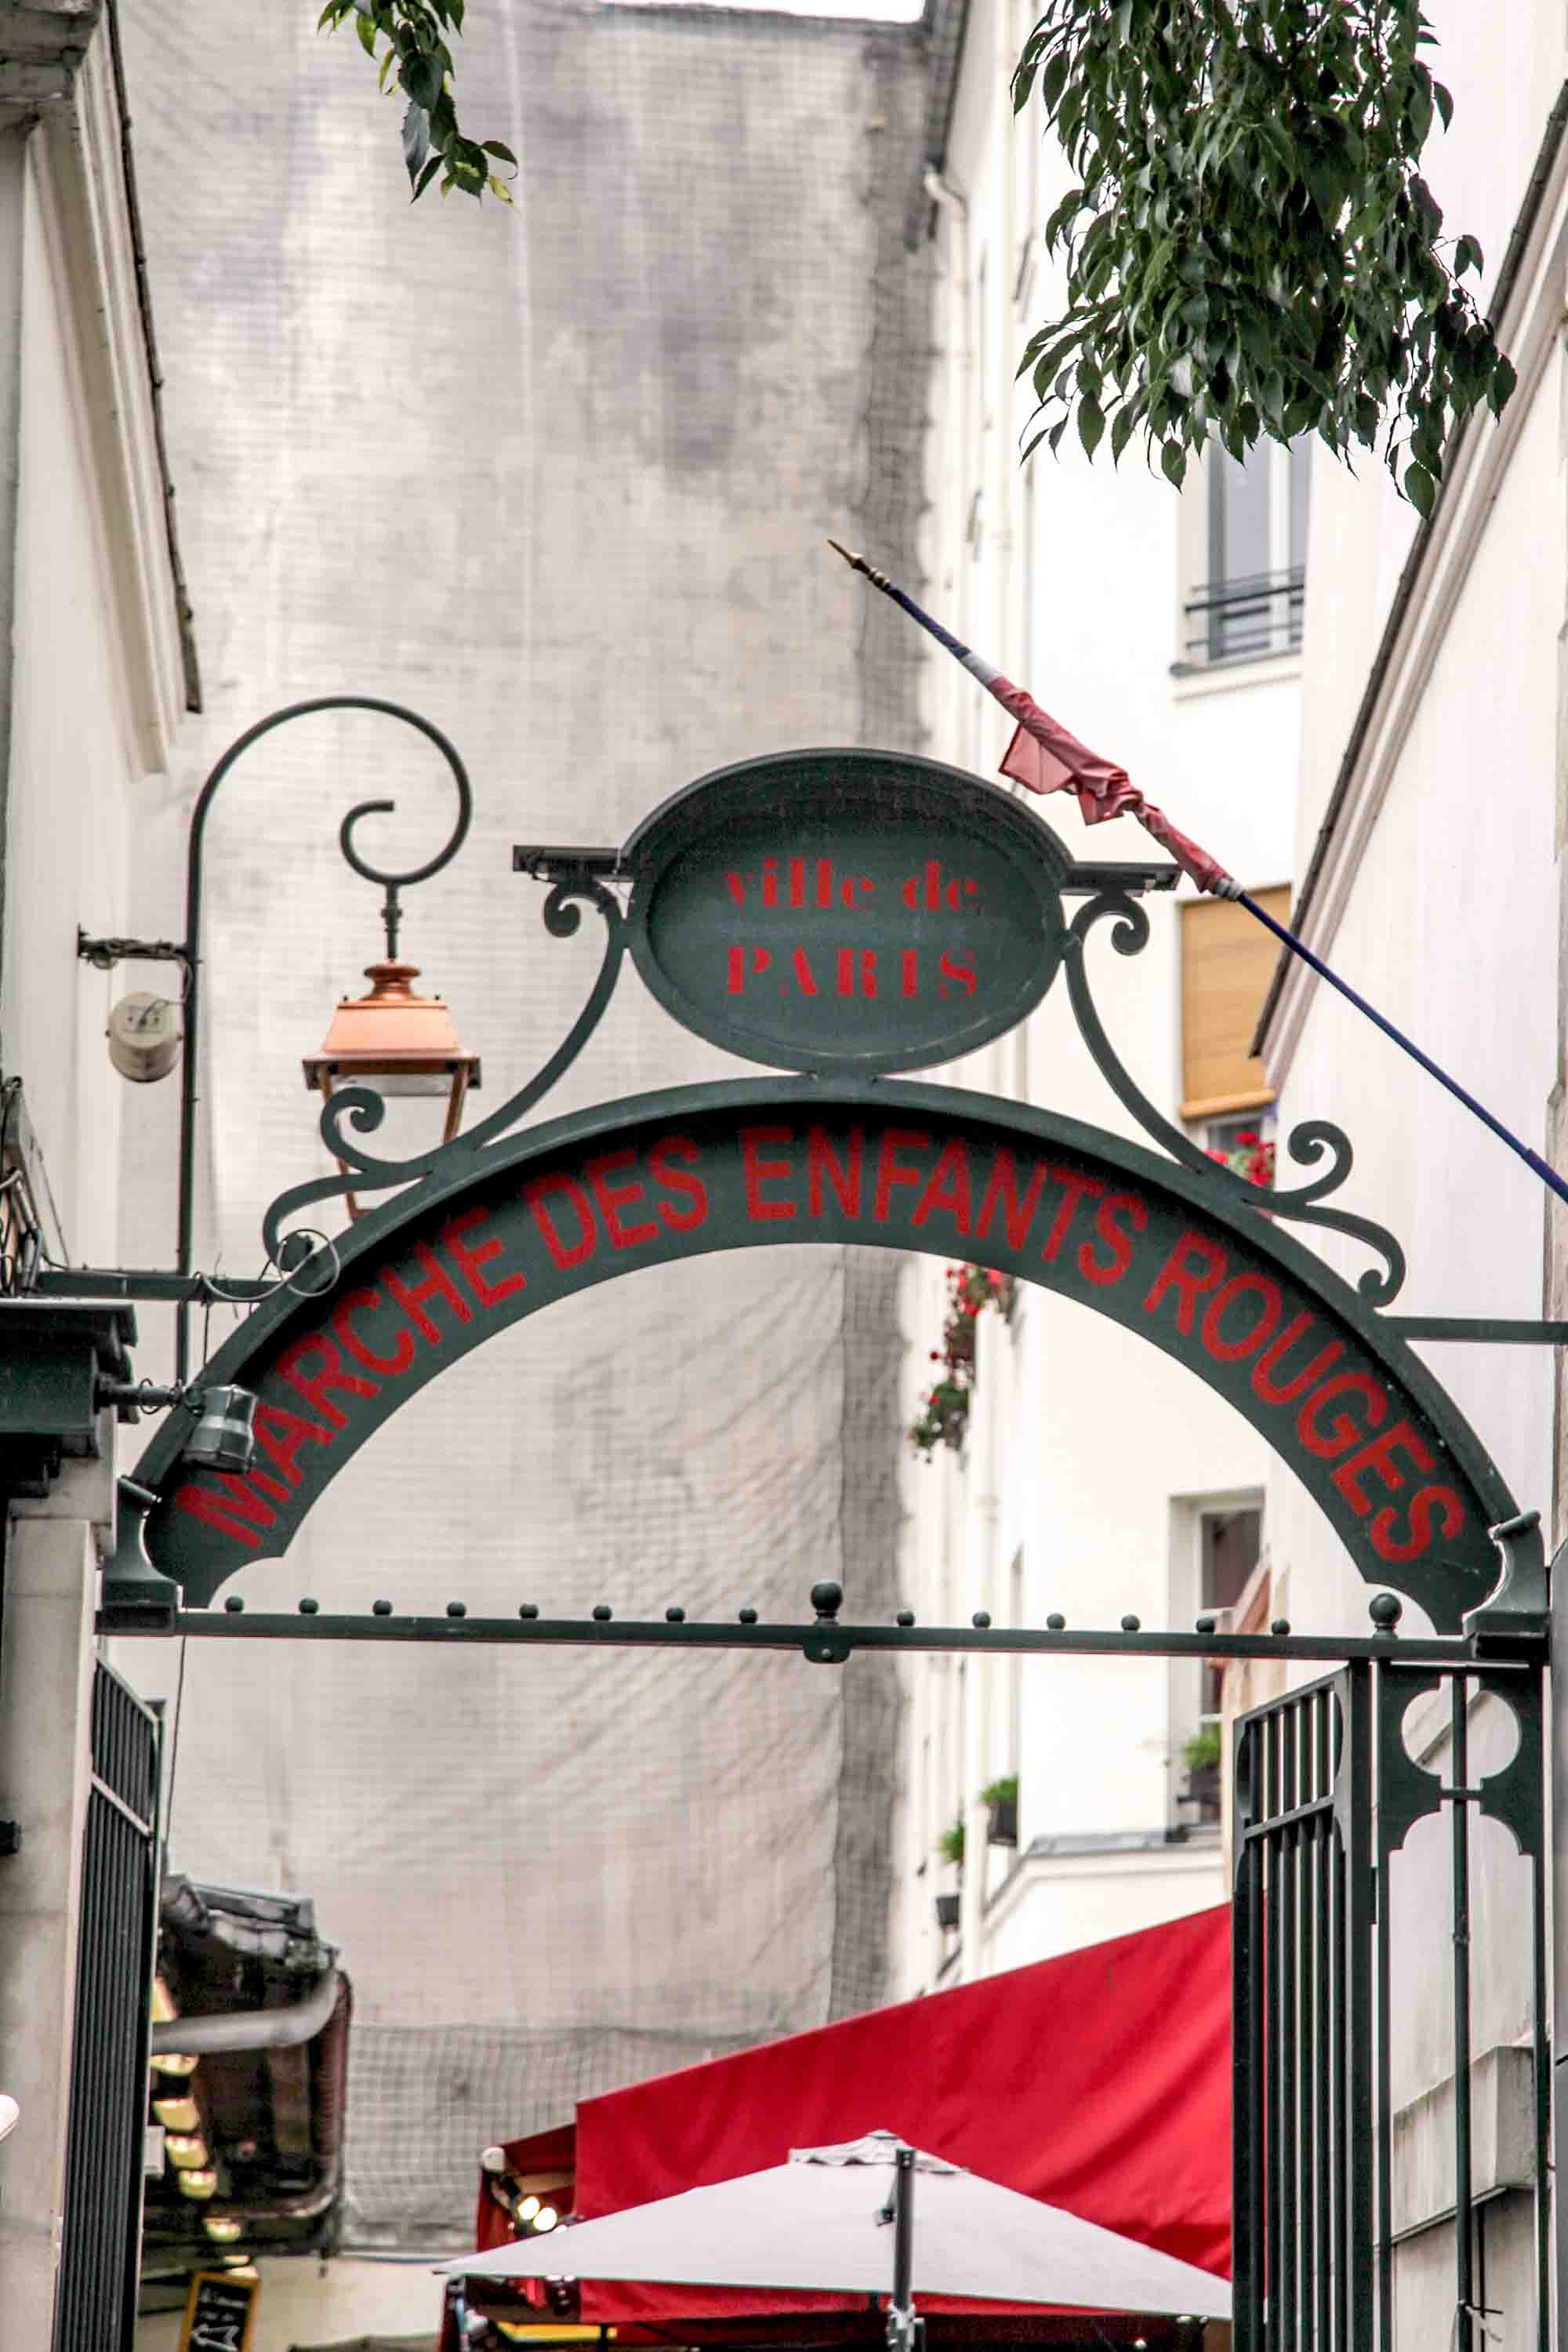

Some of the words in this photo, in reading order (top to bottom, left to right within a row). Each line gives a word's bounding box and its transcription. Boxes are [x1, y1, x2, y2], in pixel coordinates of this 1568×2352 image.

[724, 856, 876, 911] ville
[902, 859, 981, 913] de
[726, 944, 981, 1000] PARIS
[174, 1206, 528, 1550] MARCHE
[523, 1135, 710, 1273] DES
[739, 1124, 1149, 1288] ENFANTS
[1140, 1227, 1467, 1565] ROUGES
